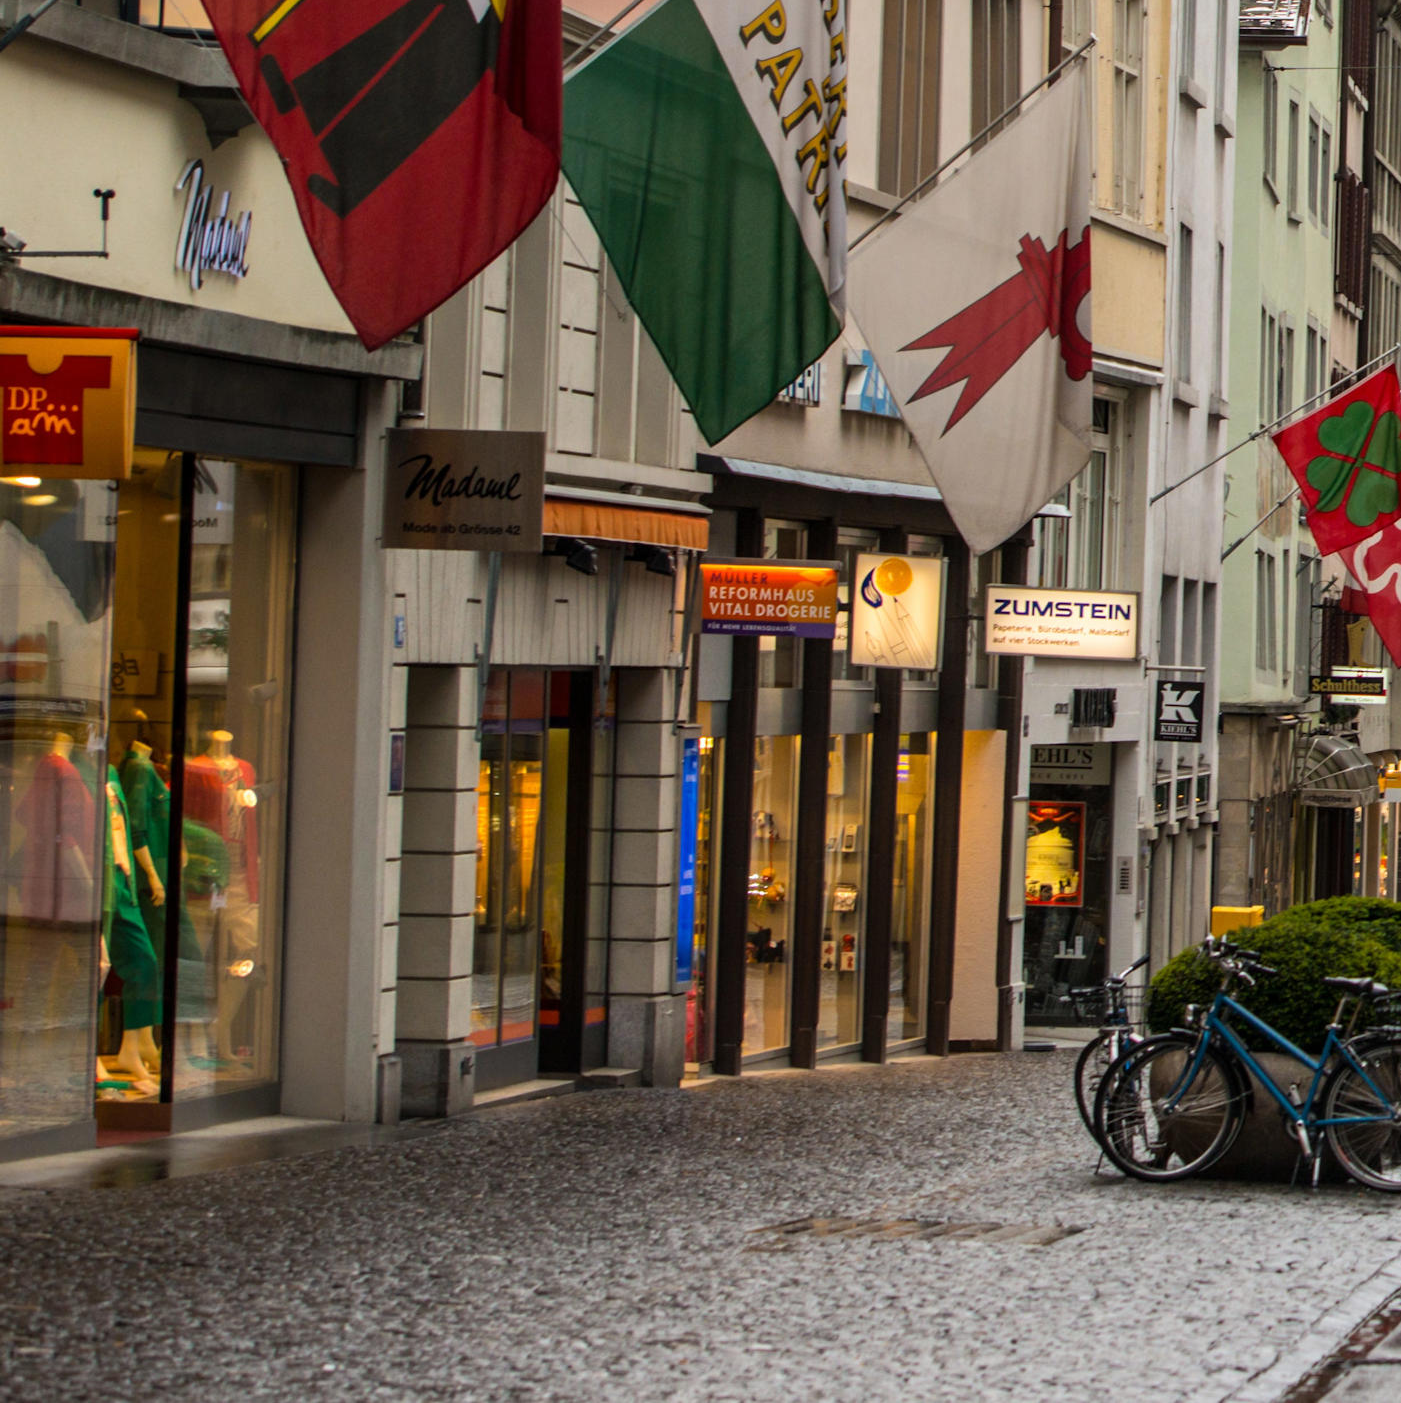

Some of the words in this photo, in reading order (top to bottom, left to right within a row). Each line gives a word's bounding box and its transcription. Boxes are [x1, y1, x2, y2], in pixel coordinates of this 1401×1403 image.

[402, 522, 439, 534] Mode
[440, 522, 456, 534] ab
[458, 523, 504, 535] Grösse
[505, 524, 521, 536] 42
[709, 568, 768, 585] MÜLLER
[709, 586, 816, 604] REFORMHAUS
[709, 602, 752, 616] VITAL
[755, 604, 832, 619] DROGERIE
[994, 599, 1131, 620] ZUMSTEIN
[707, 622, 720, 630] FÜR
[722, 623, 741, 631] MEHR
[993, 623, 1036, 634] Papeterie,
[993, 636, 1006, 645] auf
[1008, 637, 1025, 645] vier
[1311, 678, 1381, 693] Schulthess
[1161, 724, 1198, 734] KIEHL'S
[1032, 748, 1094, 765] EHL'S
